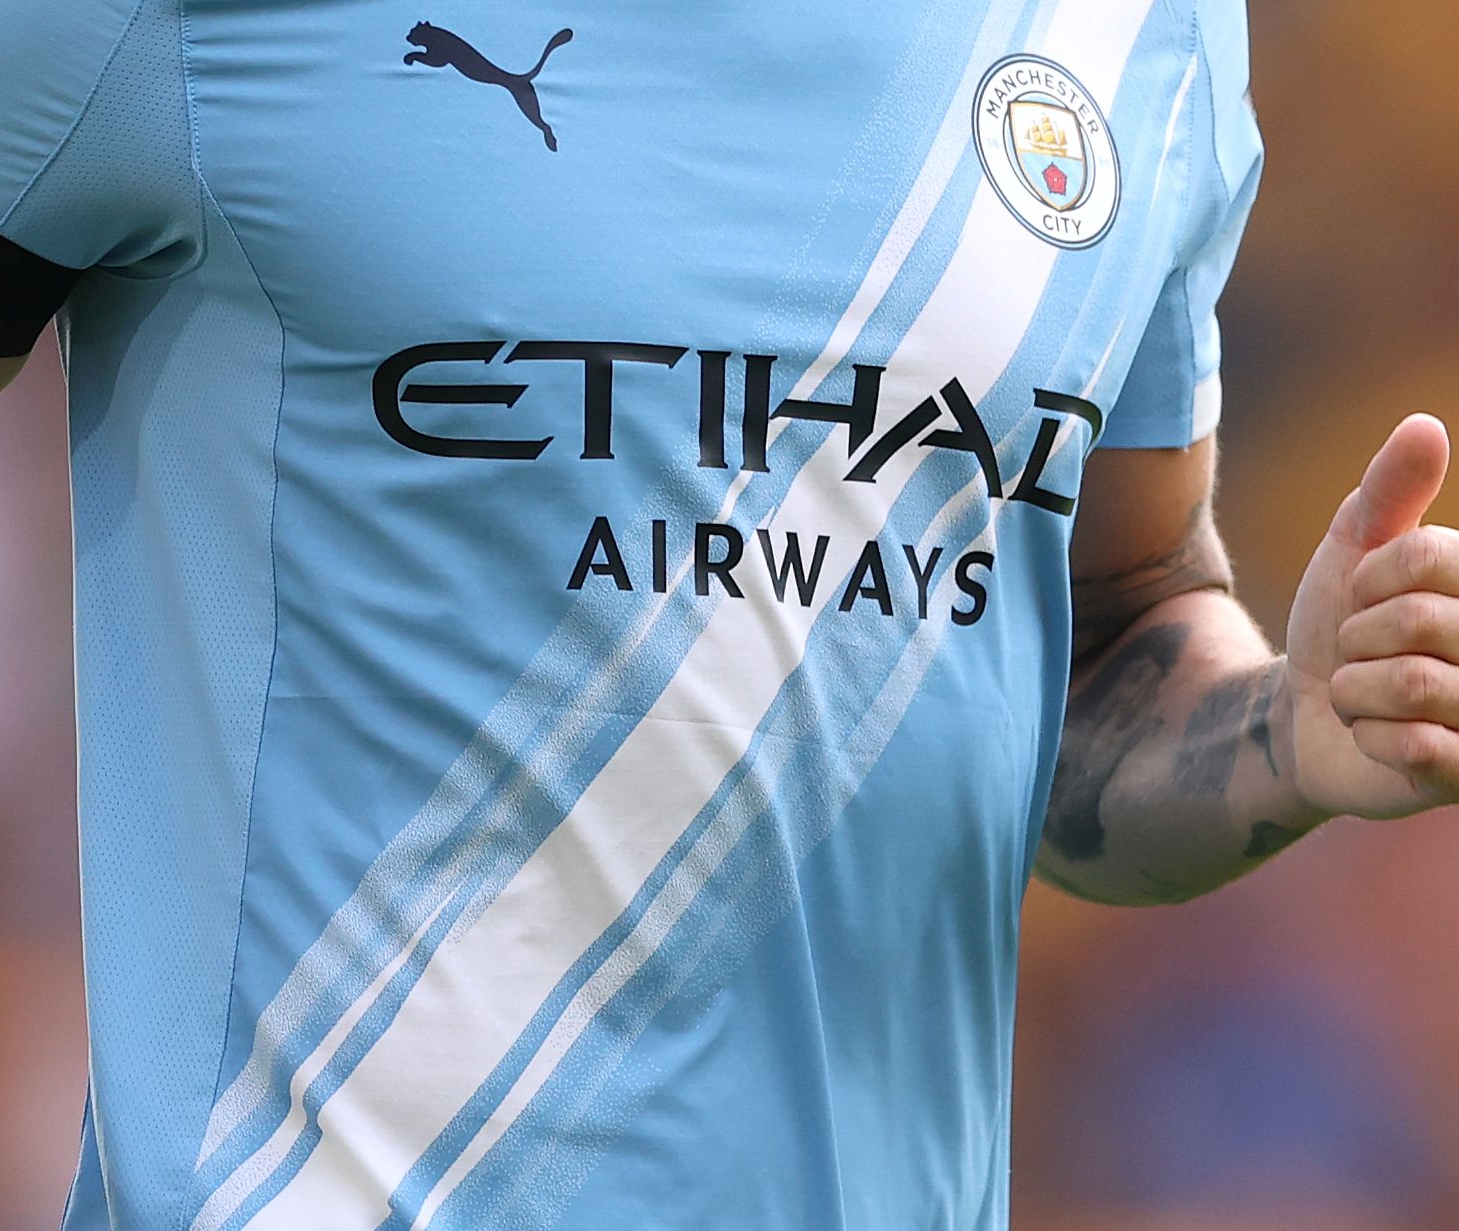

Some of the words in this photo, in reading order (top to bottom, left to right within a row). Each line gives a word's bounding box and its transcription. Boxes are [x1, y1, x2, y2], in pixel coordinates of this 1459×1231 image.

[986, 69, 1099, 134] MANCHESTER
[1042, 214, 1081, 235] CITY
[373, 340, 1103, 515] ETIHAD
[567, 515, 994, 626] AIRWAYS
